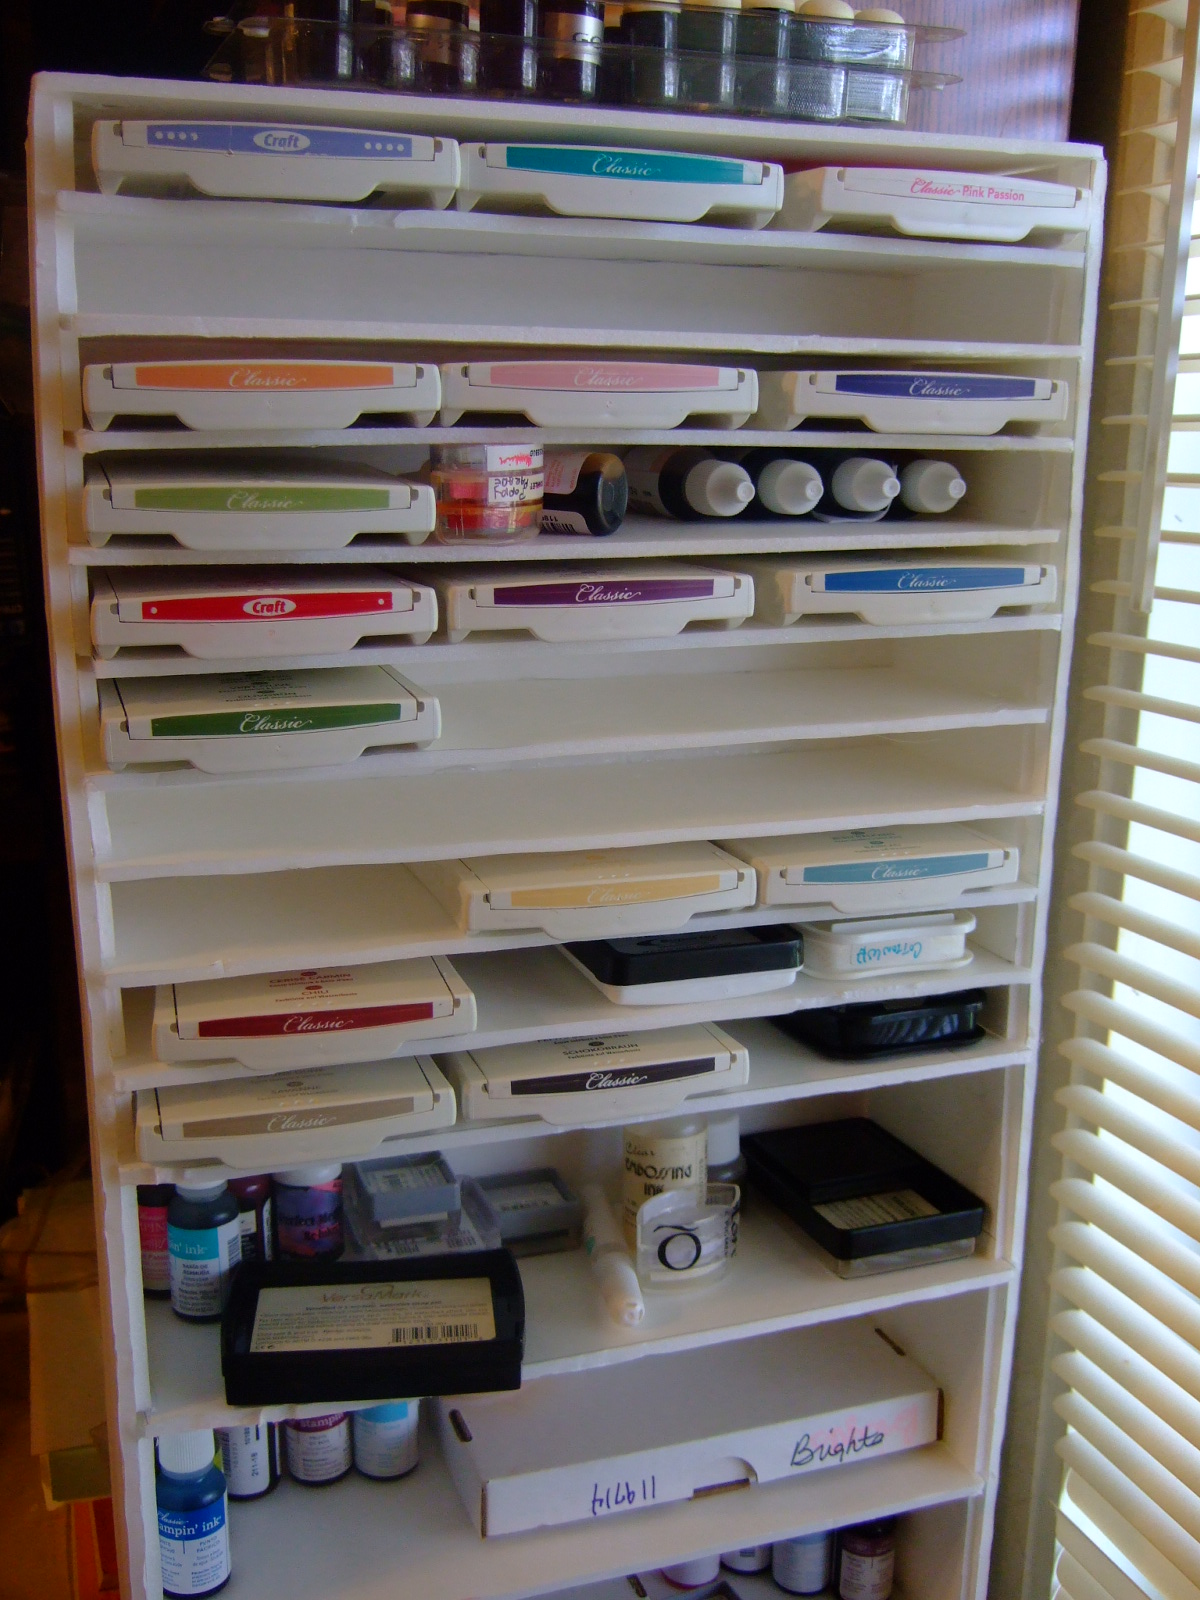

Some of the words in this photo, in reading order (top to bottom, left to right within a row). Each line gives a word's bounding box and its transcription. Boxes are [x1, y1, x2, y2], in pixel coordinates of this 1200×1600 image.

[263, 132, 301, 150] Craft
[592, 153, 662, 177] Classic
[910, 177, 960, 197] Classic
[962, 185, 985, 199] Pink
[987, 188, 1025, 202] Passion
[228, 367, 307, 389] Classic
[574, 366, 644, 387] Classic
[908, 377, 970, 397] Classic
[226, 488, 303, 511] Classic
[897, 571, 956, 589] Classic
[575, 583, 641, 603] Classic
[252, 599, 286, 616] Craft
[239, 713, 312, 734] Classic
[871, 863, 928, 881] Classic
[587, 886, 651, 904] Classic
[283, 1015, 354, 1034] Classic
[562, 1043, 638, 1056] SCHOKOBRAUN
[585, 1071, 648, 1091] Classic
[267, 1113, 336, 1133] Classic
[625, 1141, 655, 1157] Clear
[185, 1243, 206, 1255] ink
[159, 1523, 198, 1537] ampin'
[202, 1515, 220, 1532] ink
